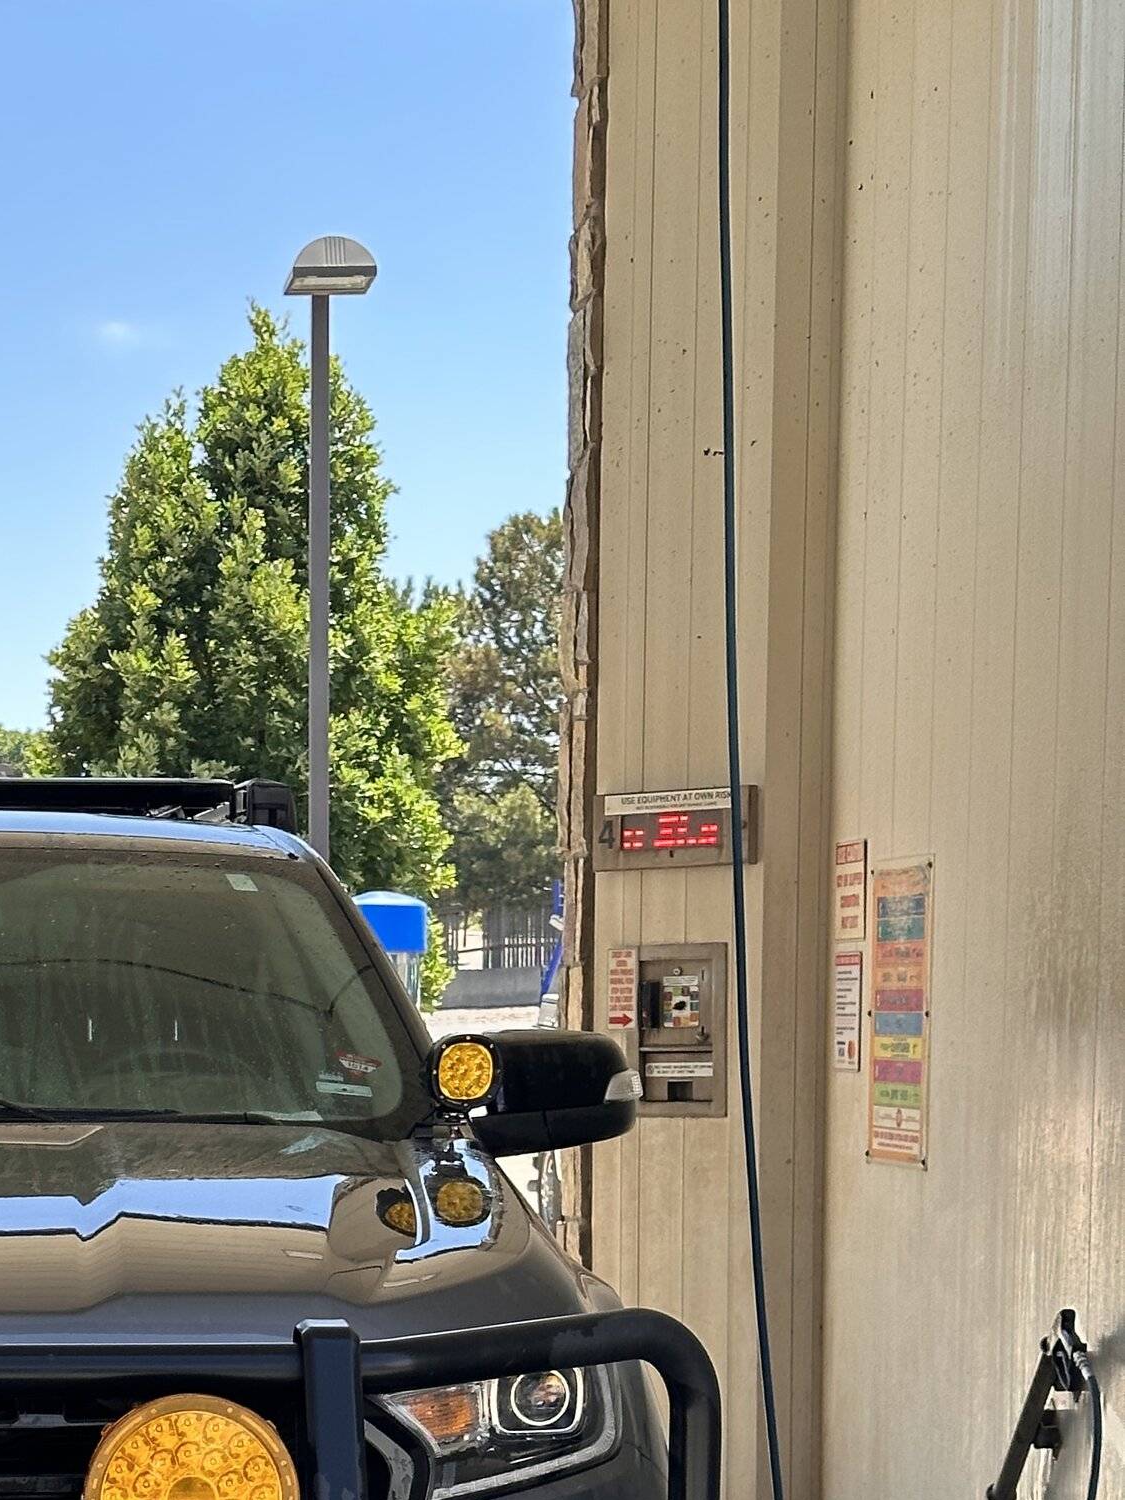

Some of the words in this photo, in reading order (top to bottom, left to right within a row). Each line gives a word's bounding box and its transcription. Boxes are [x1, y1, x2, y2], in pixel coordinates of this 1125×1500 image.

[621, 796, 636, 806] USE
[637, 793, 681, 805] EQUIPMENT
[682, 792, 695, 802] AT
[695, 791, 714, 801] OWN
[598, 819, 616, 850] 4
